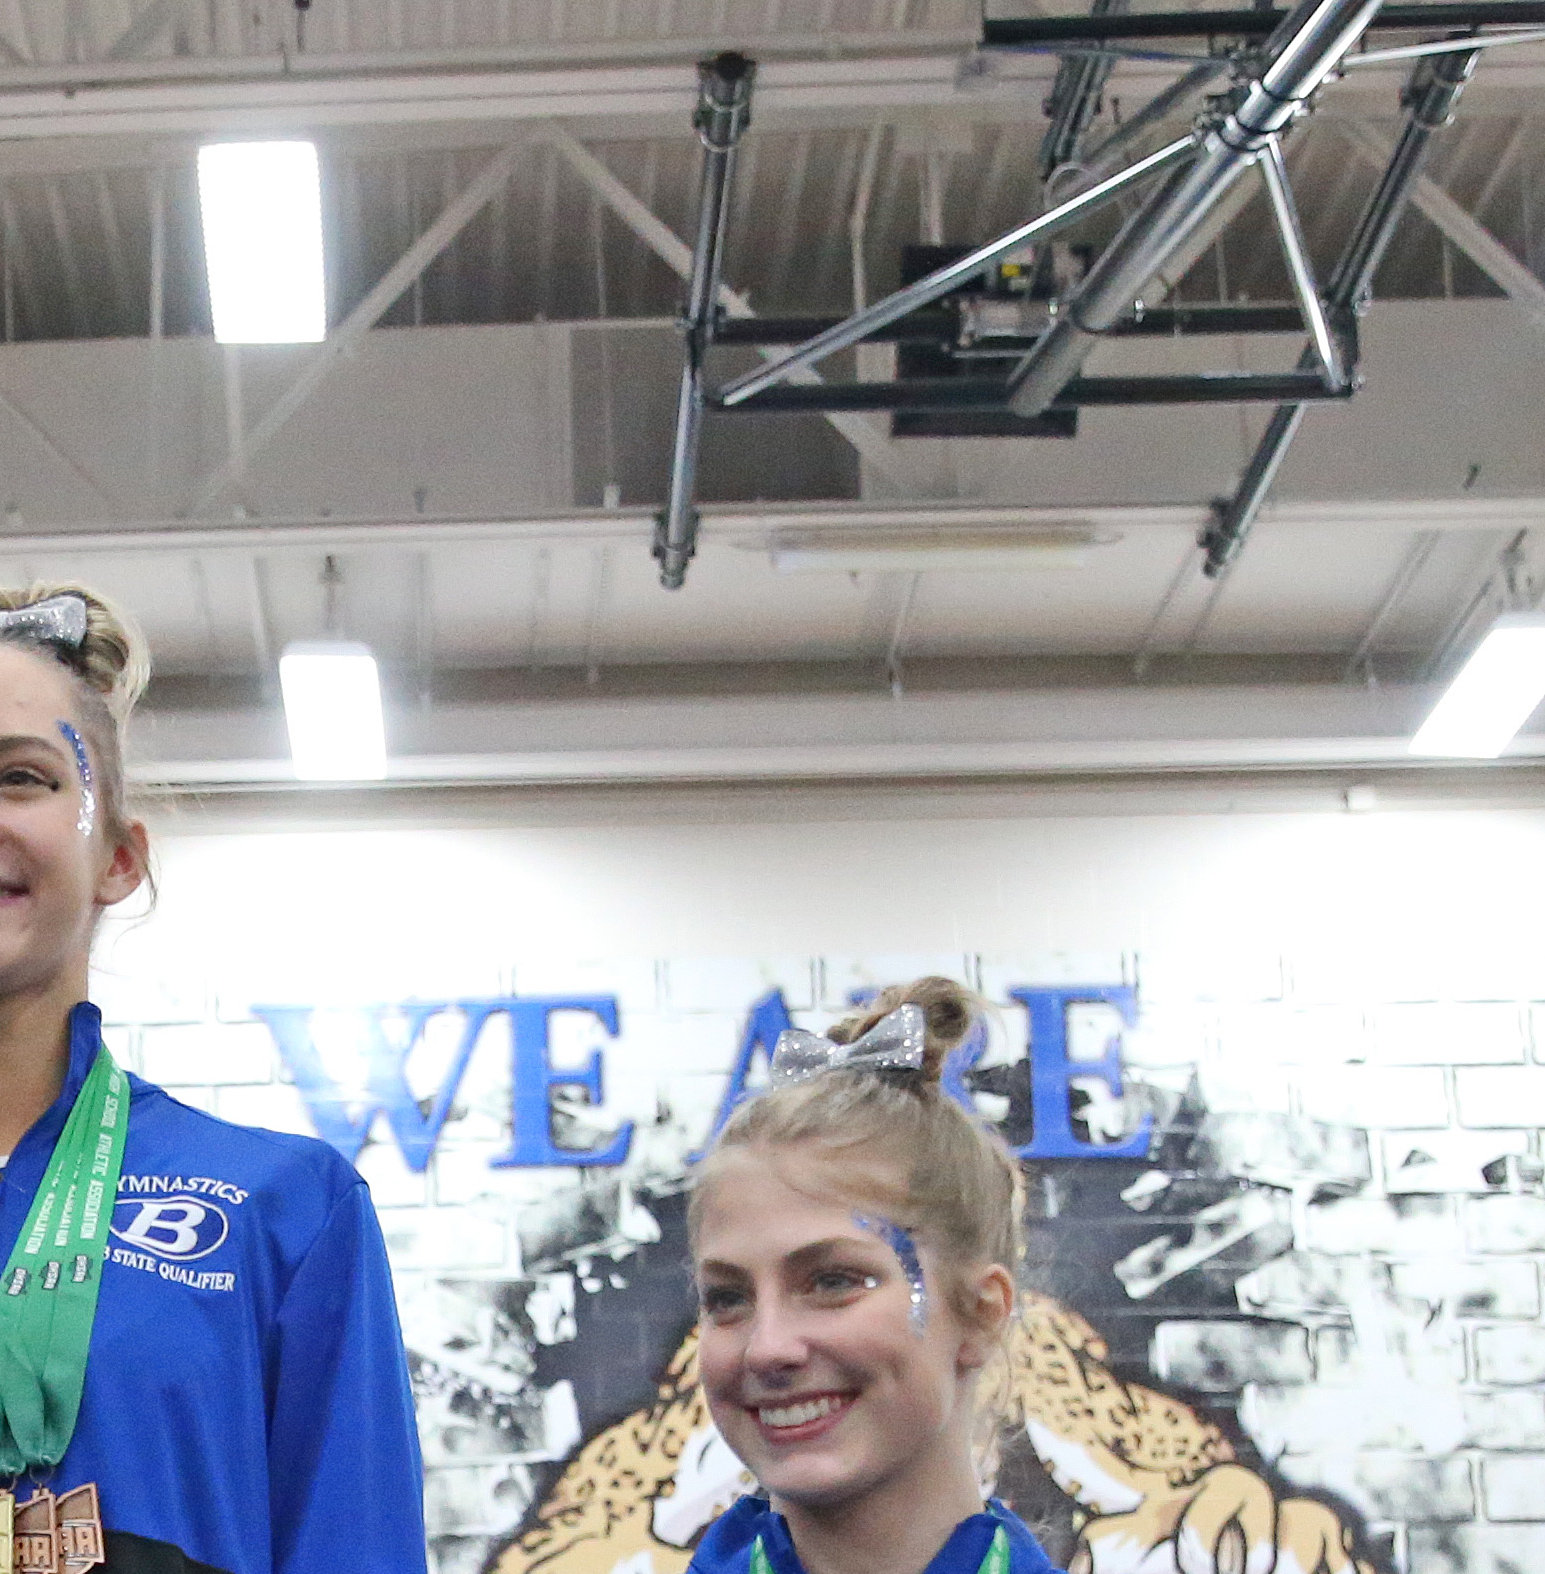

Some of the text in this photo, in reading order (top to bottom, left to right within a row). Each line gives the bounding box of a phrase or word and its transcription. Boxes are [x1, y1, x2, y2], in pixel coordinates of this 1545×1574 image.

[250, 993, 634, 1172] WE
[92, 1132, 113, 1176] ATHLETIC
[80, 1179, 104, 1239] ASSOCIATION
[116, 1175, 249, 1204] YMNASTICS
[120, 1202, 206, 1253] B
[111, 1248, 156, 1272] STATE
[159, 1263, 236, 1291] QUALIFIER
